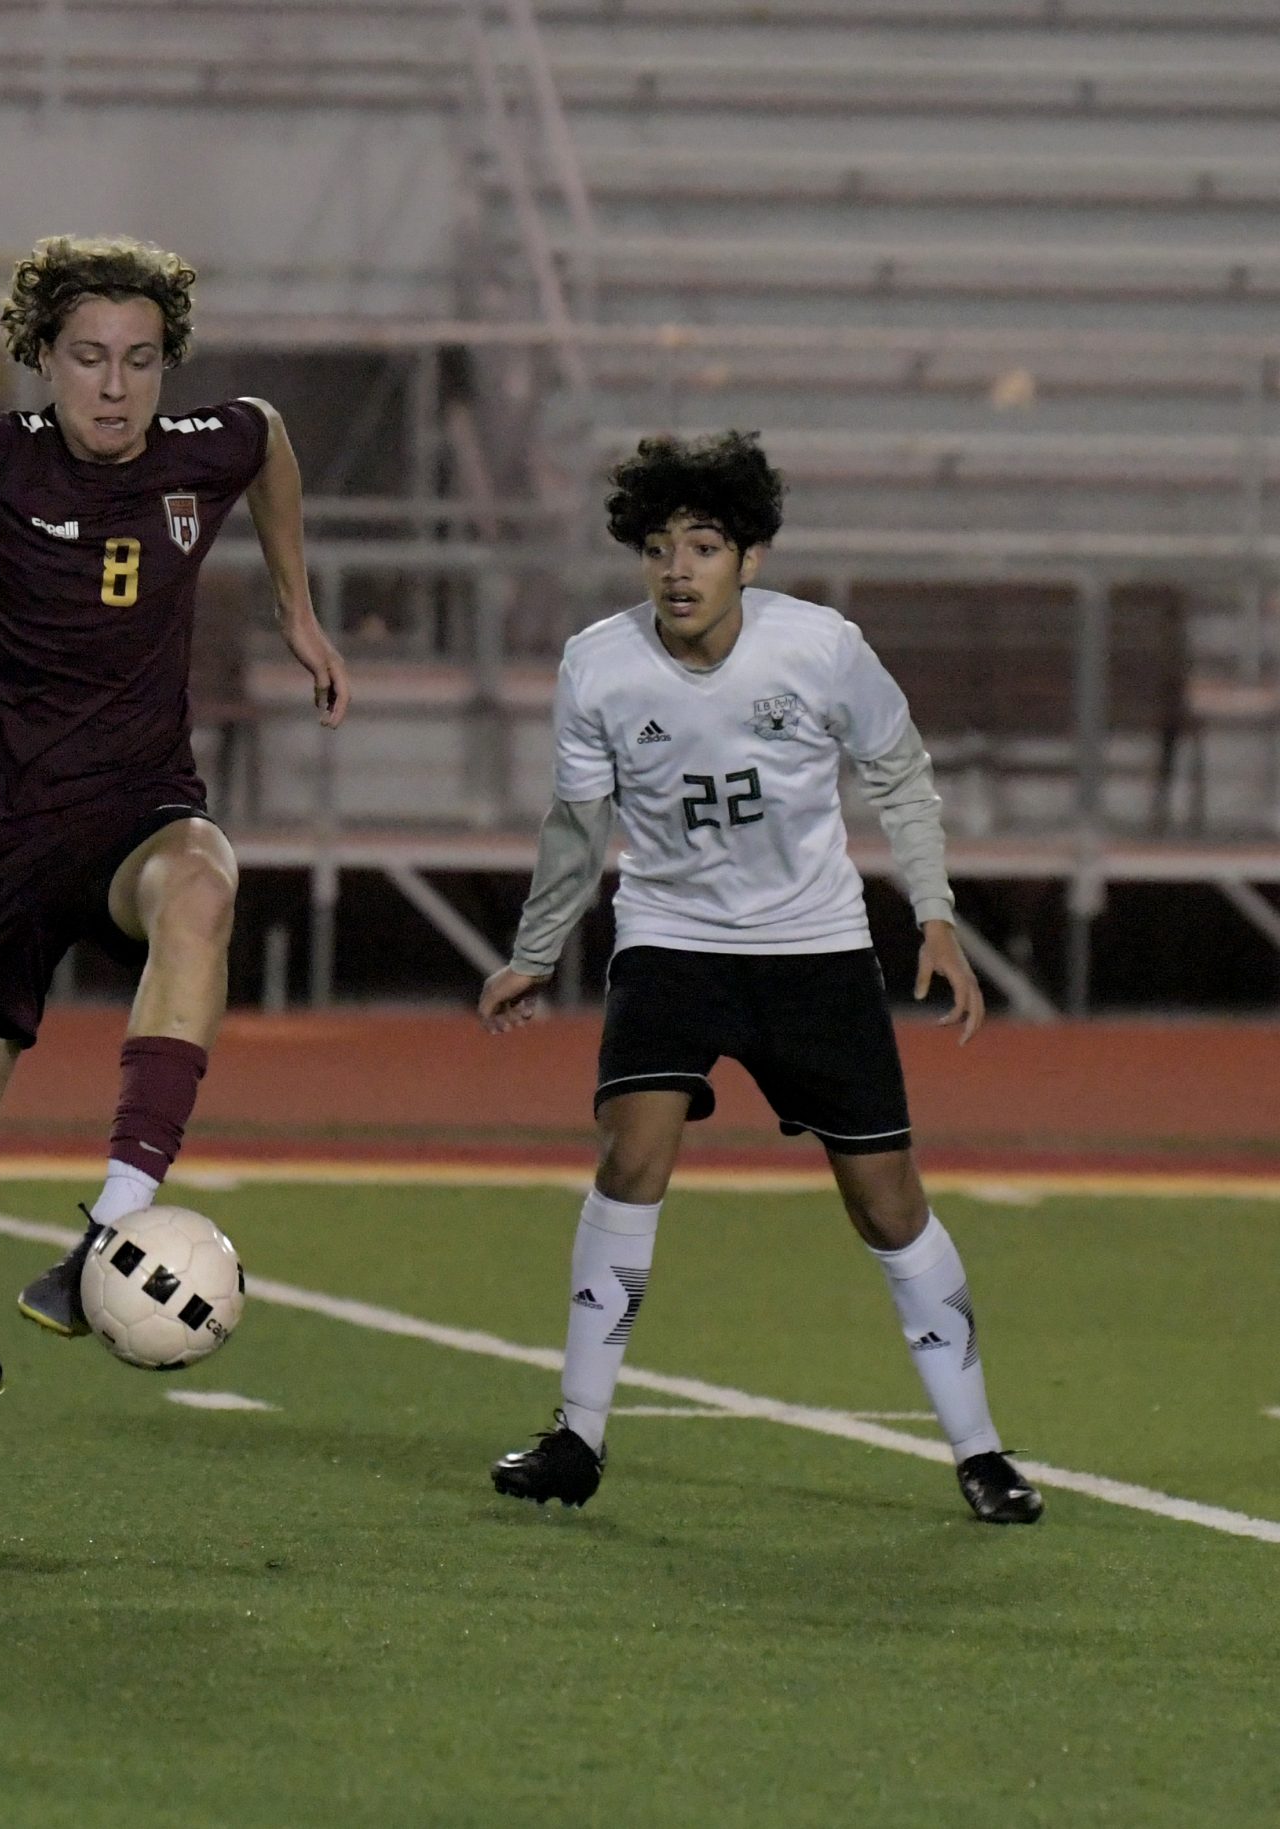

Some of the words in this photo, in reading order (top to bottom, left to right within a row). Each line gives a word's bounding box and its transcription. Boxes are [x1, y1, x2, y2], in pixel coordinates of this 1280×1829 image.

[101, 537, 141, 607] 8
[637, 734, 672, 744] adidas
[683, 767, 764, 830] 22
